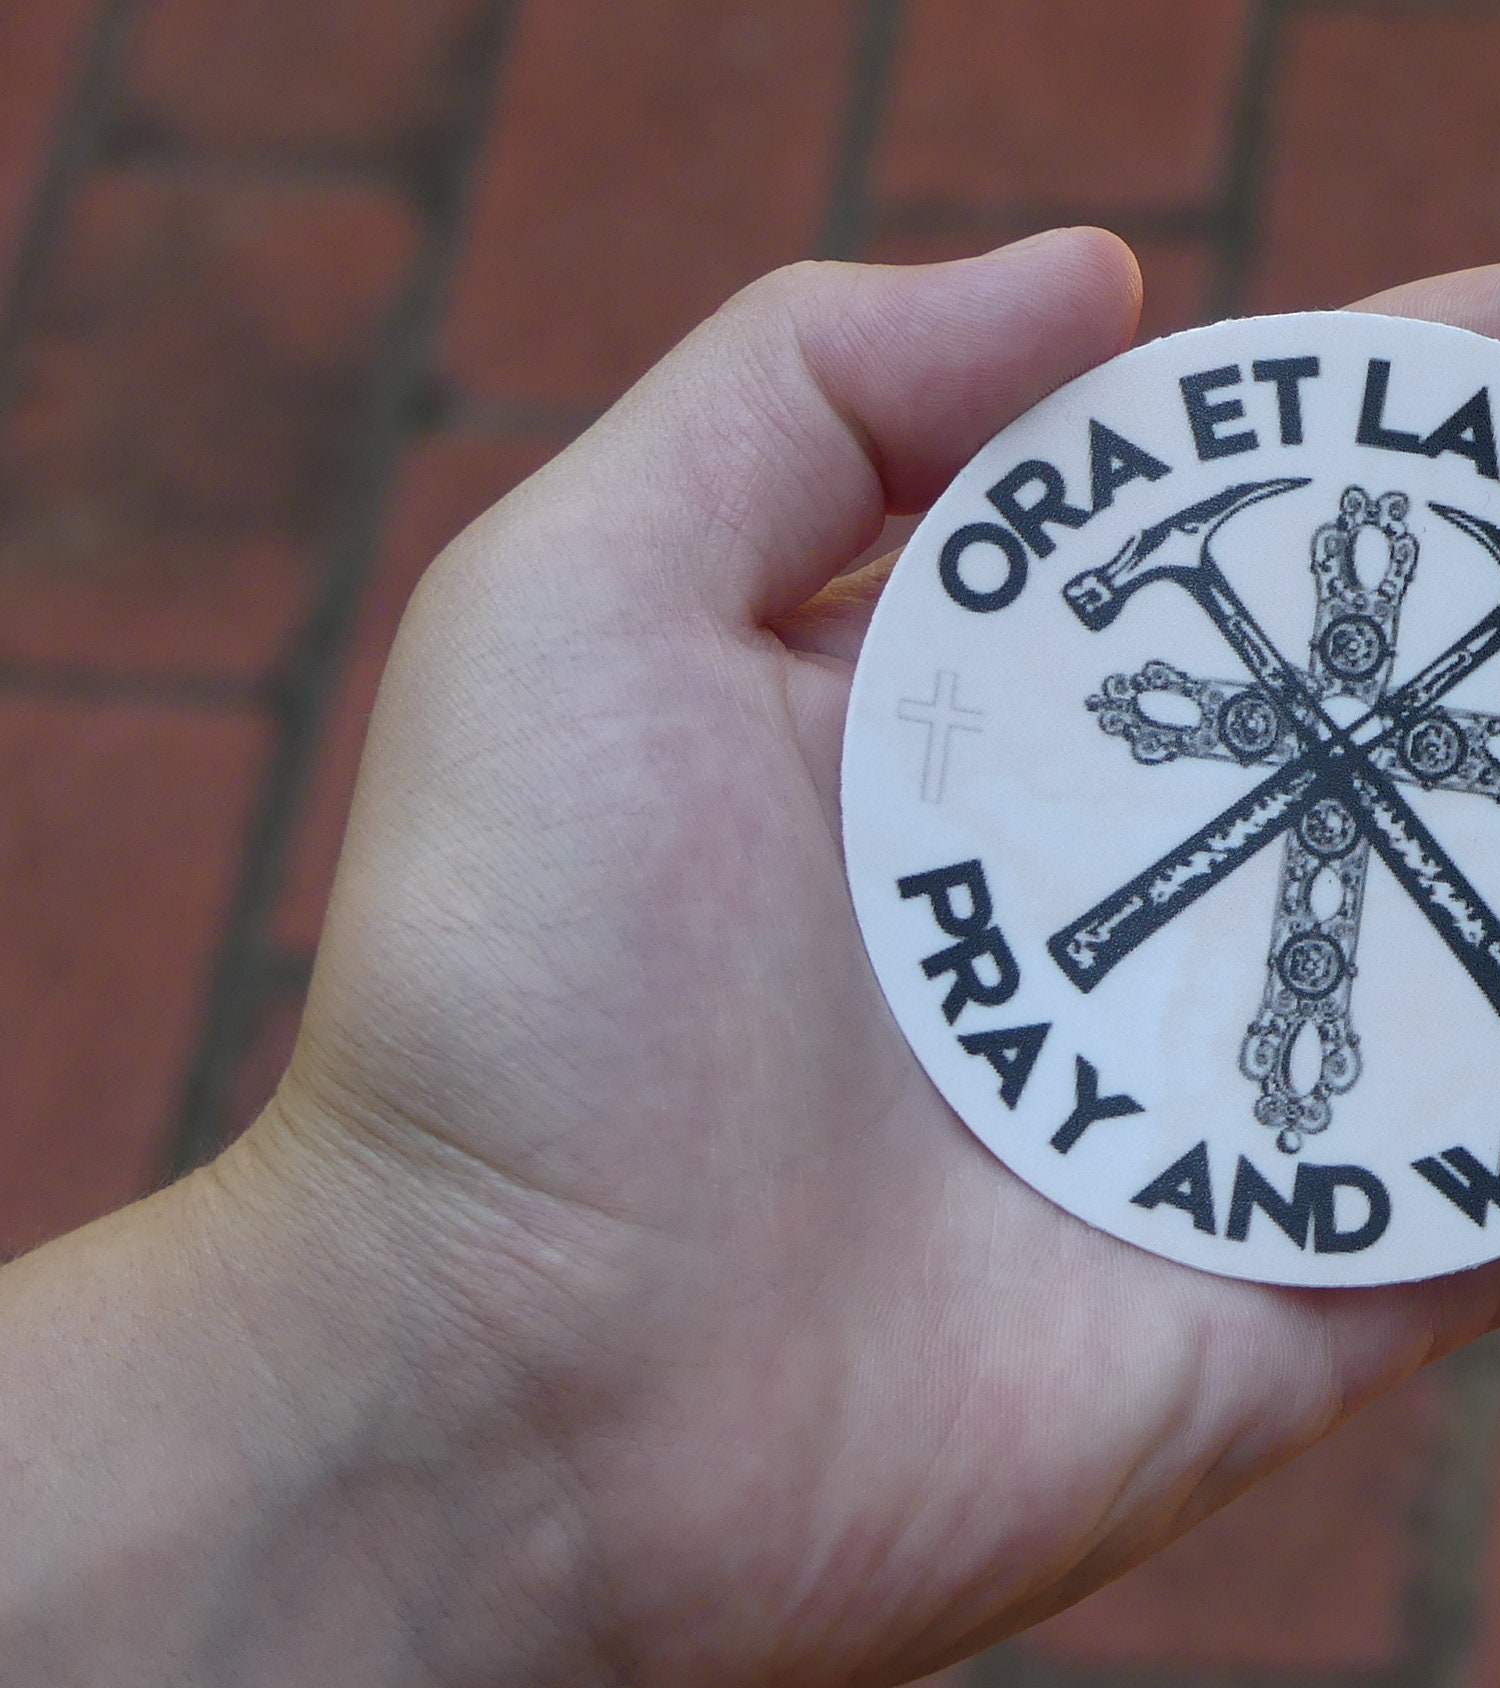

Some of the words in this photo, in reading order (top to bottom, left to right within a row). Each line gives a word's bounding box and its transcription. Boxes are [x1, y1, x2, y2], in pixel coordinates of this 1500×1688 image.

[938, 418, 1172, 614] ORA
[1179, 356, 1320, 462] ET
[896, 859, 1146, 1155] PRAY
[1130, 1140, 1391, 1255] AND
